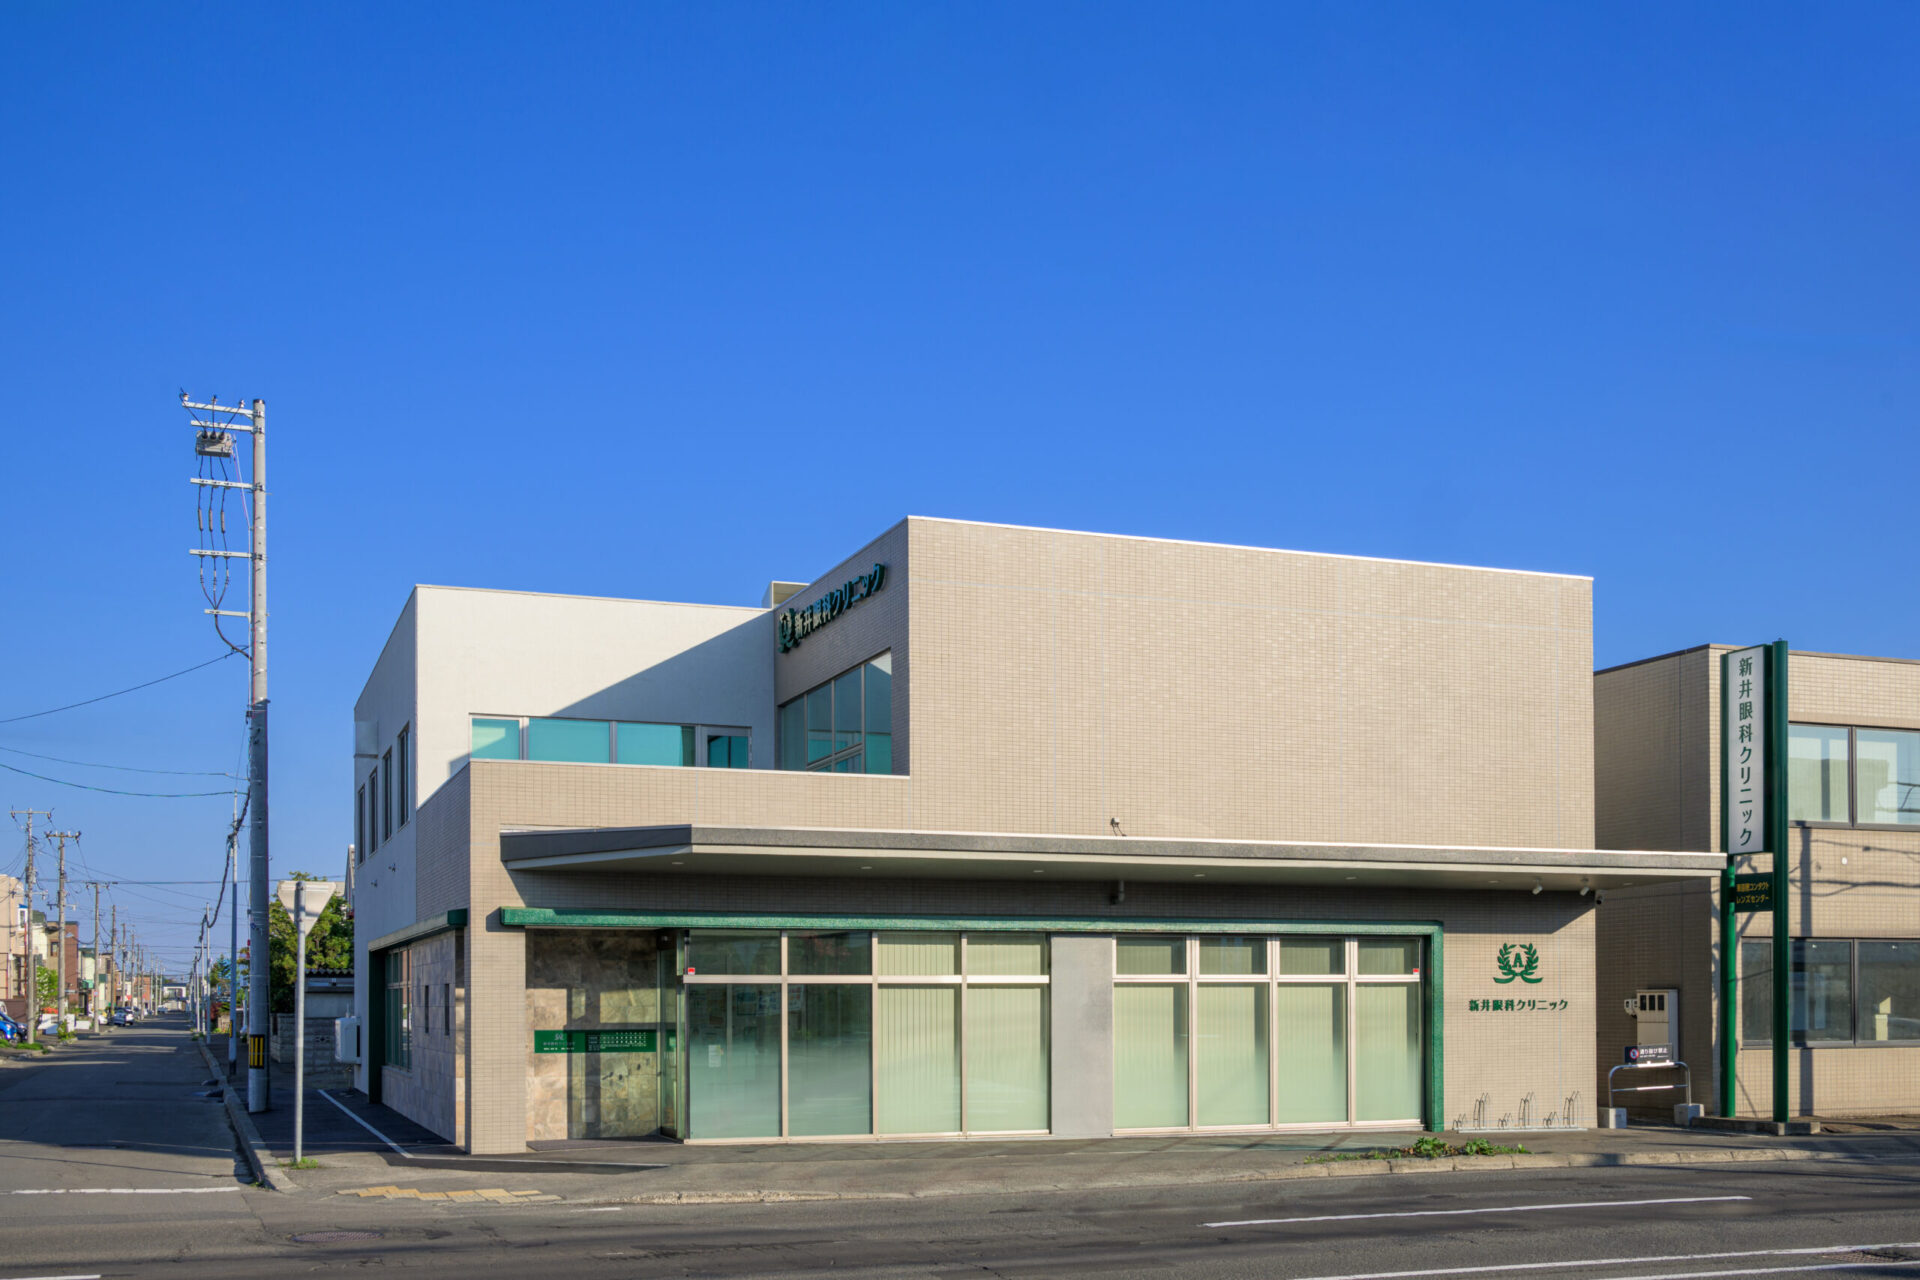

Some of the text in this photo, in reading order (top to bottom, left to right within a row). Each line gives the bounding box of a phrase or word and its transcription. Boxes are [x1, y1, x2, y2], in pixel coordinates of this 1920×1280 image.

[1738, 656, 1753, 847] 新井眼科クリニック
[1512, 952, 1525, 968] A
[1468, 999, 1568, 1012] 新井眼科クリニック
